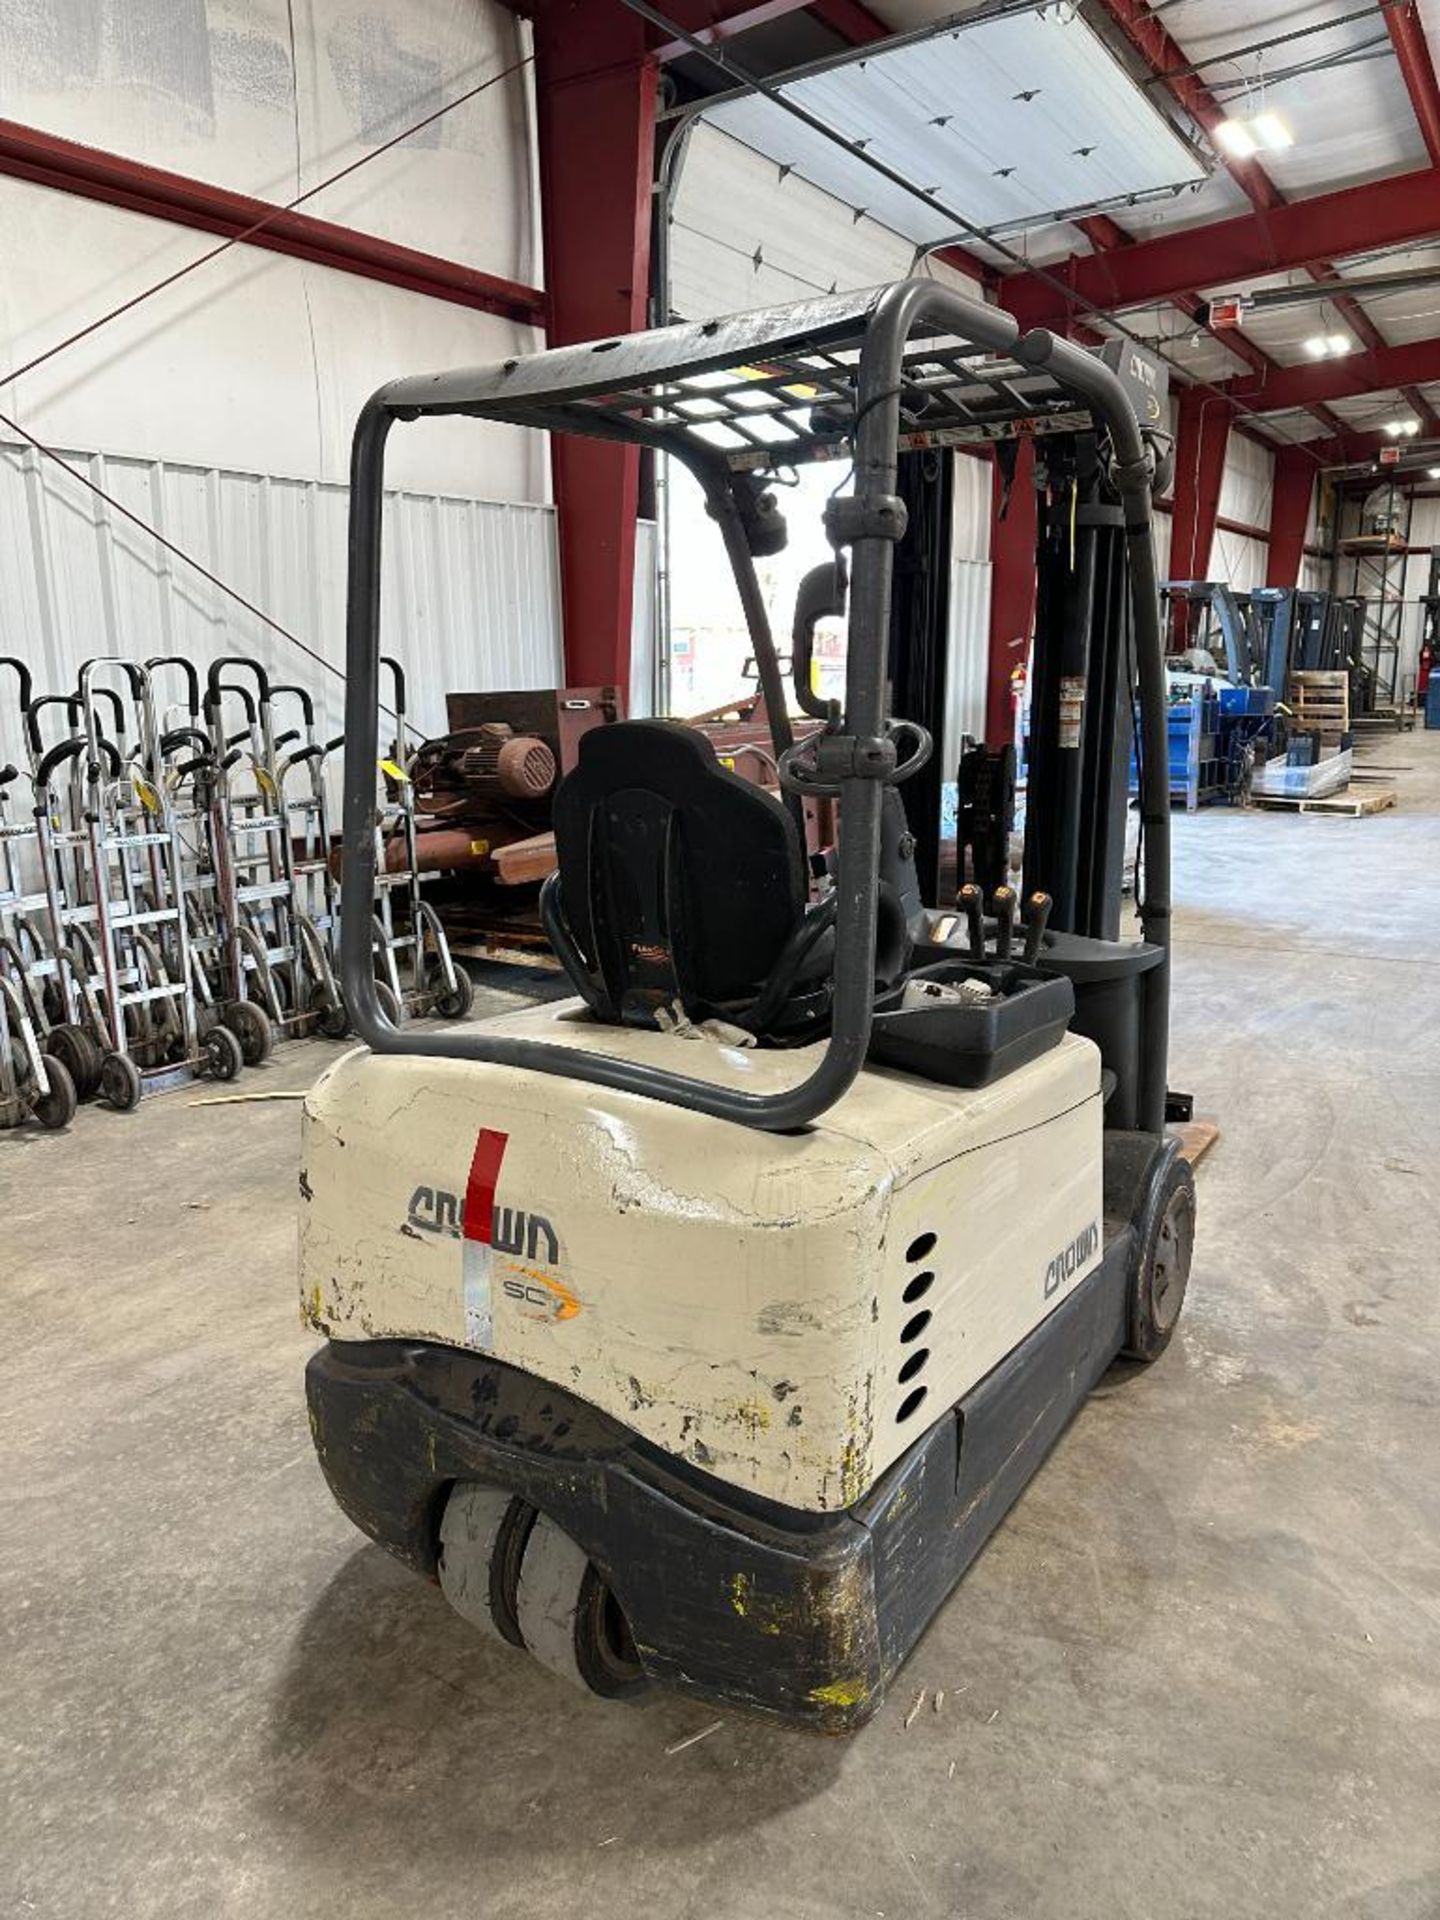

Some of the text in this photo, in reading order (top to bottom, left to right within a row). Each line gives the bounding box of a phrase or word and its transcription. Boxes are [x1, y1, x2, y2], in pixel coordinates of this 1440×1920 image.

[407, 1185, 559, 1265] CRWN
[1044, 1221, 1099, 1300] CROWN
[503, 1280, 547, 1306] SC
